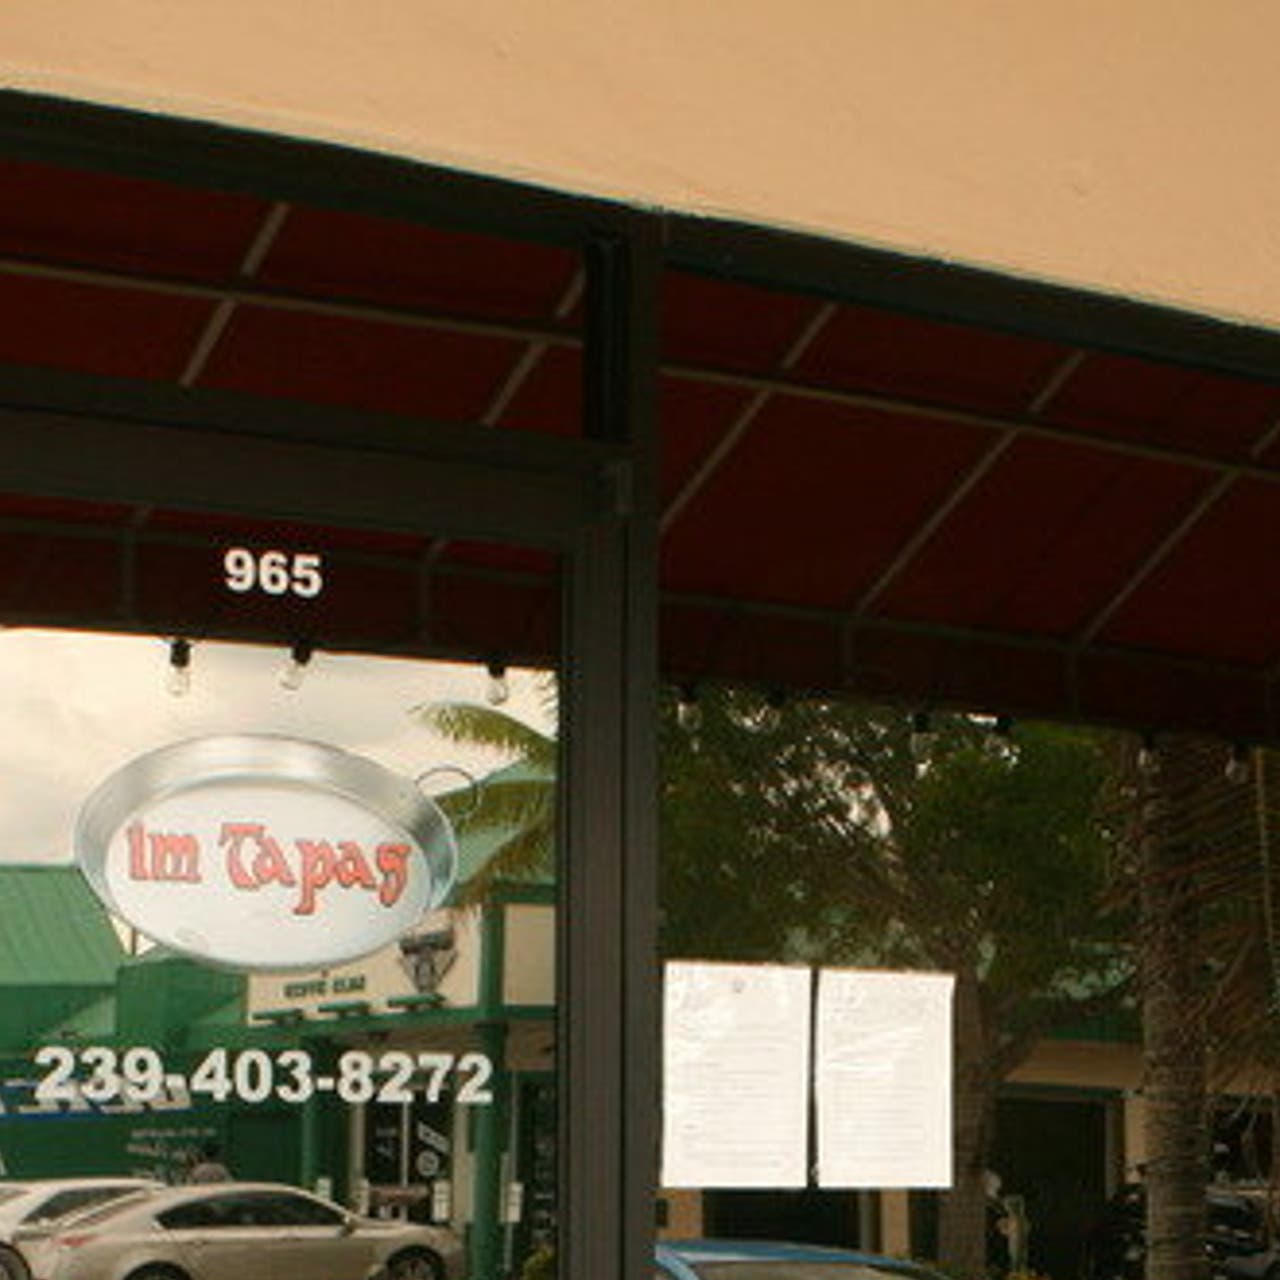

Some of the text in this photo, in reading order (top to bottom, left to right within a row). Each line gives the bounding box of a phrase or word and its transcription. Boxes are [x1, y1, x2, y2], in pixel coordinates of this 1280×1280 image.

[224, 547, 323, 598] 965
[218, 822, 412, 916] Tapas
[33, 1045, 494, 1105] 239-403-8272
